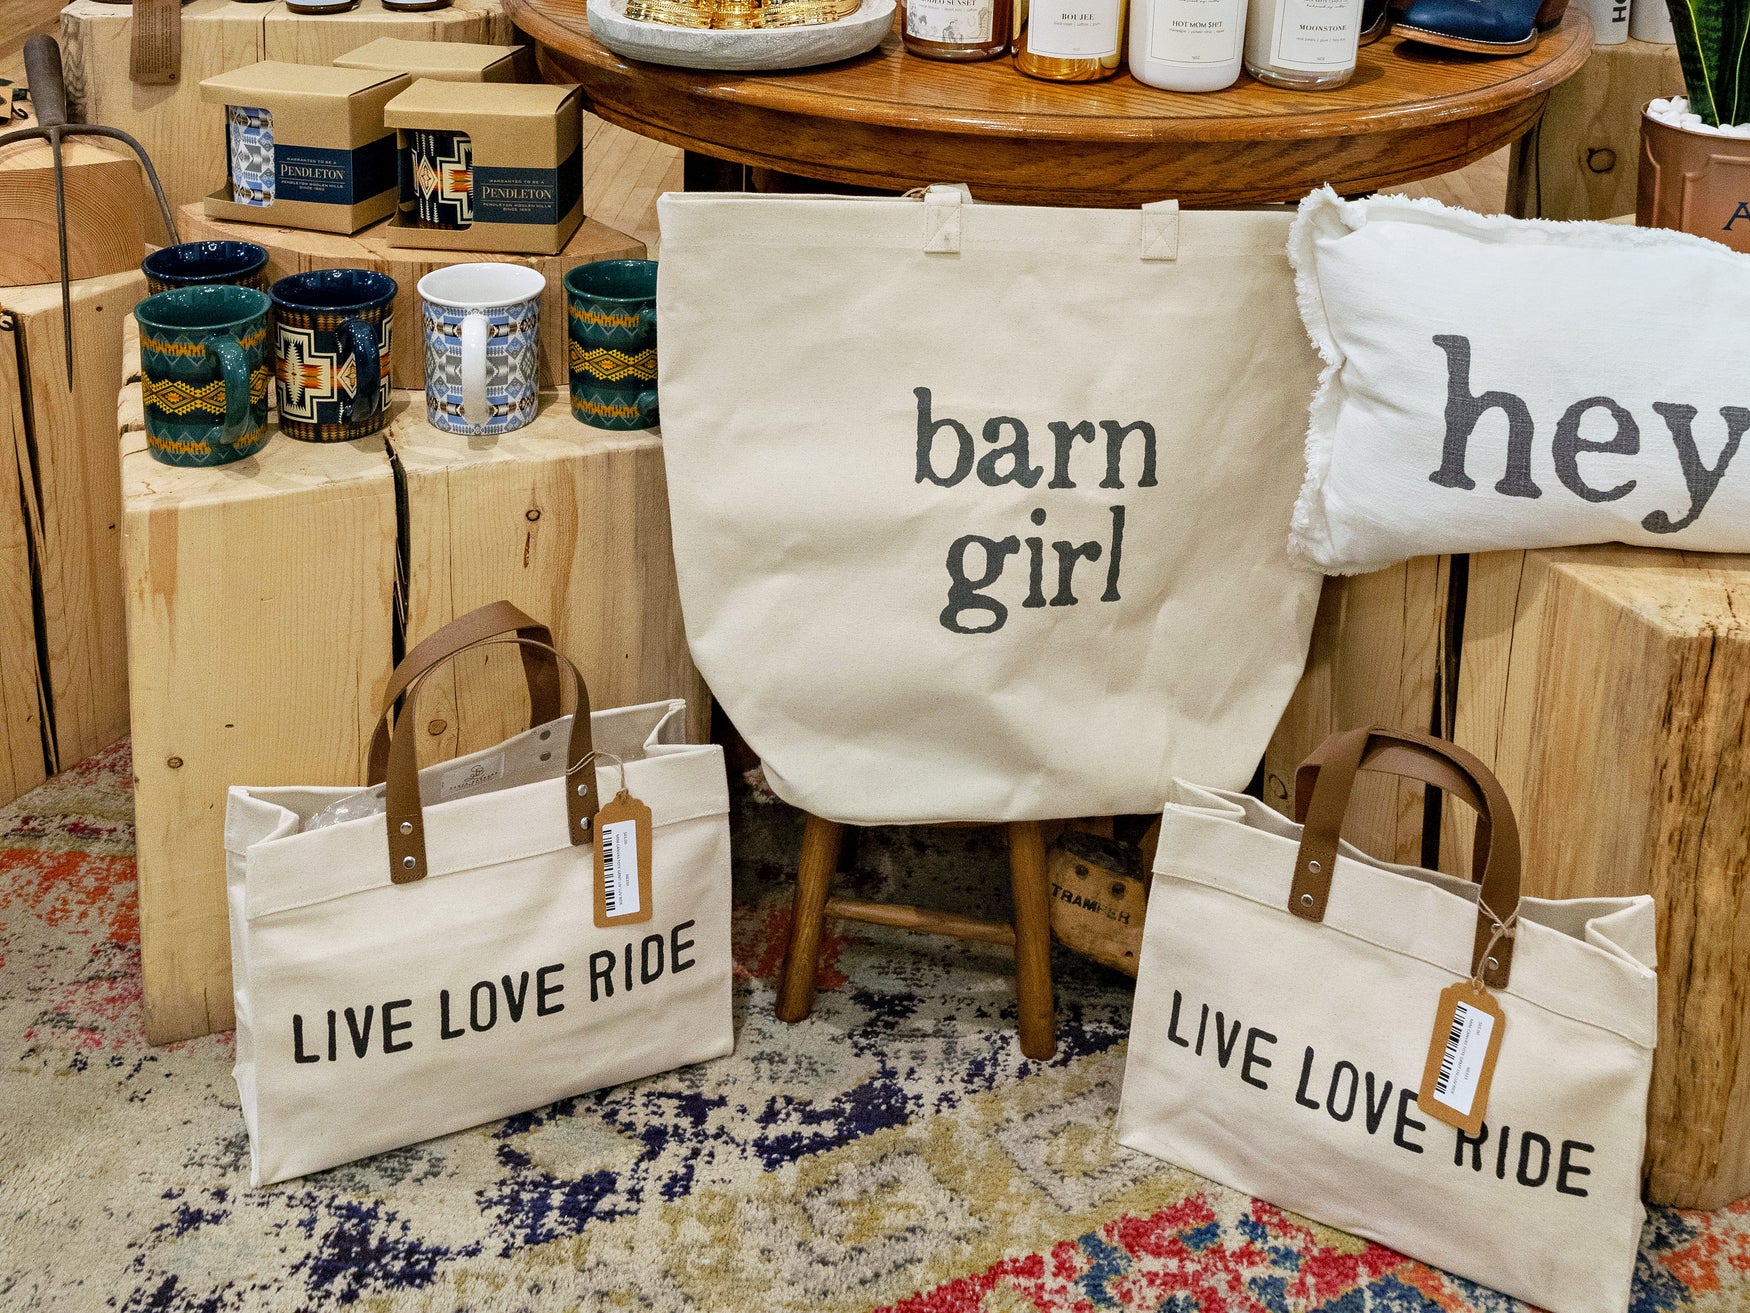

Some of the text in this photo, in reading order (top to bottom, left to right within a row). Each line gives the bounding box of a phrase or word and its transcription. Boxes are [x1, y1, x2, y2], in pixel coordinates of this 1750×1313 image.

[1062, 13, 1095, 21] BOUJEE
[280, 164, 344, 180] PENDLETON
[482, 186, 552, 199] PENDLETON
[913, 387, 1158, 489] barn
[1429, 335, 1750, 534] hey
[940, 505, 1125, 634] girl
[293, 920, 695, 1063] LIVE LOVE RIDE
[1168, 990, 1277, 1090] LIVE
[1296, 1046, 1426, 1154] LOVE
[1454, 1121, 1594, 1198] RIDE
